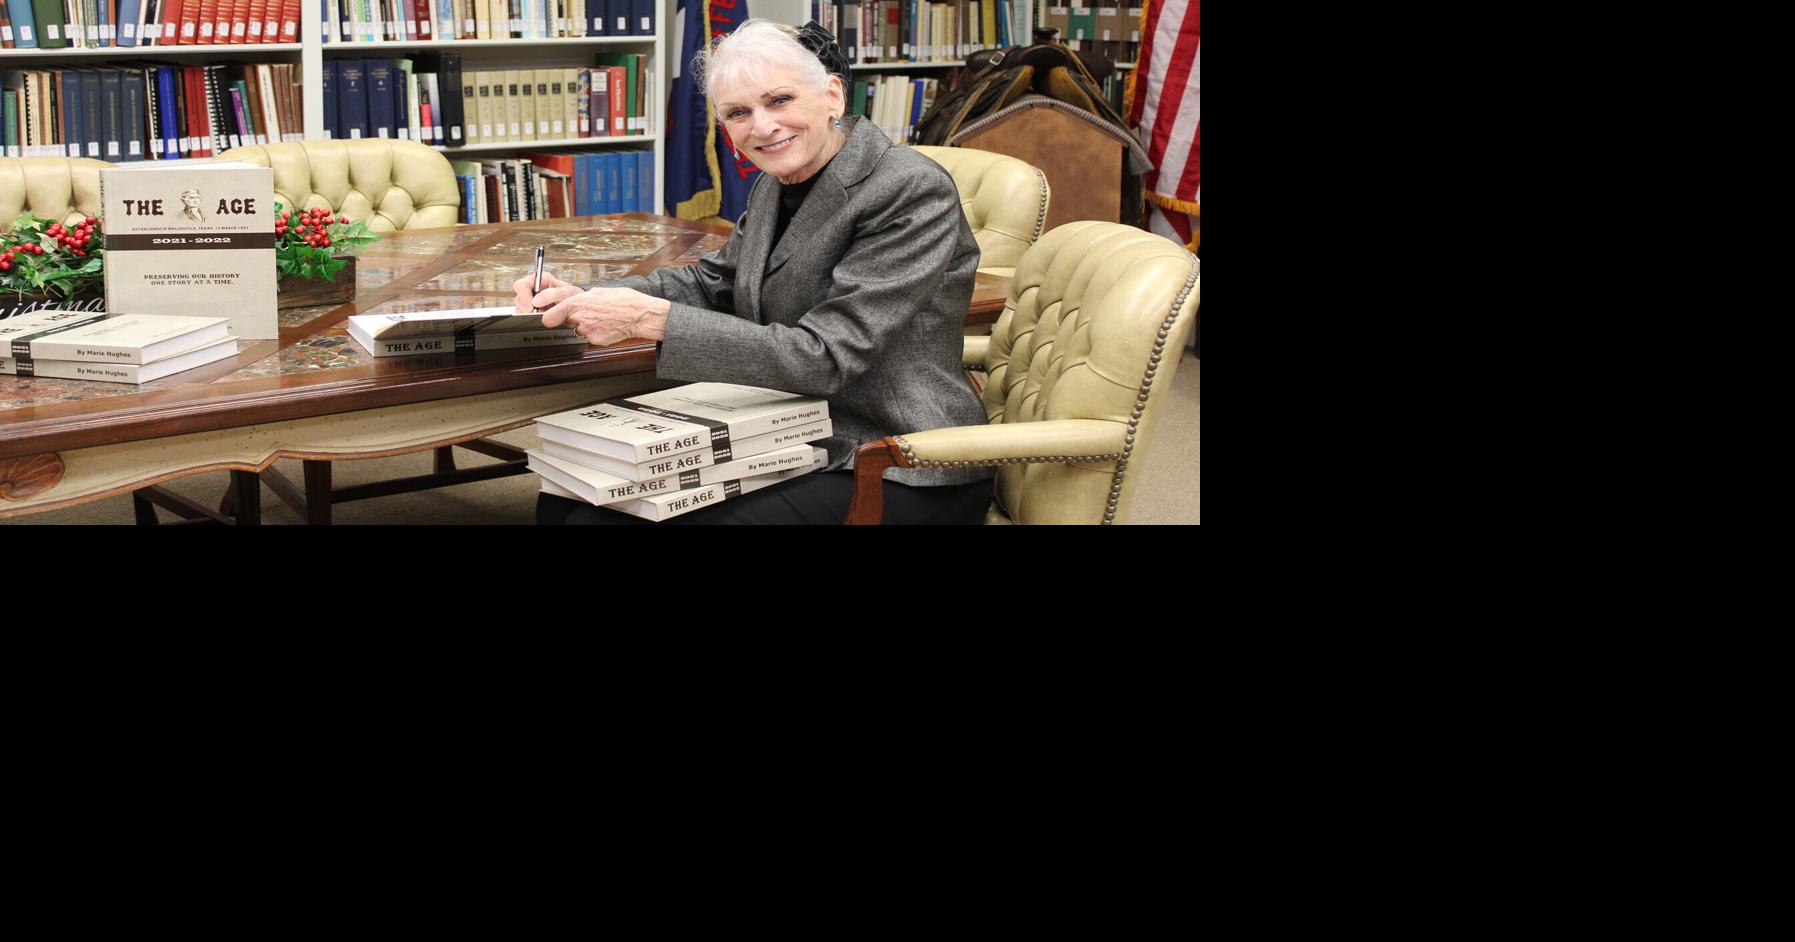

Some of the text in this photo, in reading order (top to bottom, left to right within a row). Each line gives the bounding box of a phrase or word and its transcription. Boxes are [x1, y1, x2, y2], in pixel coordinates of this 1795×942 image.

[123, 199, 164, 216] THE
[216, 198, 257, 215] AGE
[87, 349, 105, 357] Marie
[385, 341, 443, 353] THE AGE
[86, 368, 103, 376] Marie
[104, 369, 128, 377] Hughes
[781, 415, 797, 423] Marie
[798, 410, 820, 419] Hughes
[784, 433, 800, 441] Marie
[801, 428, 823, 438] Hughes
[647, 435, 700, 455] THE AGE
[649, 454, 702, 475] THE AGE
[758, 460, 777, 469] Marie
[778, 456, 803, 465] Hughes
[608, 479, 667, 498] THE AGE
[667, 490, 715, 512] THE AGE
